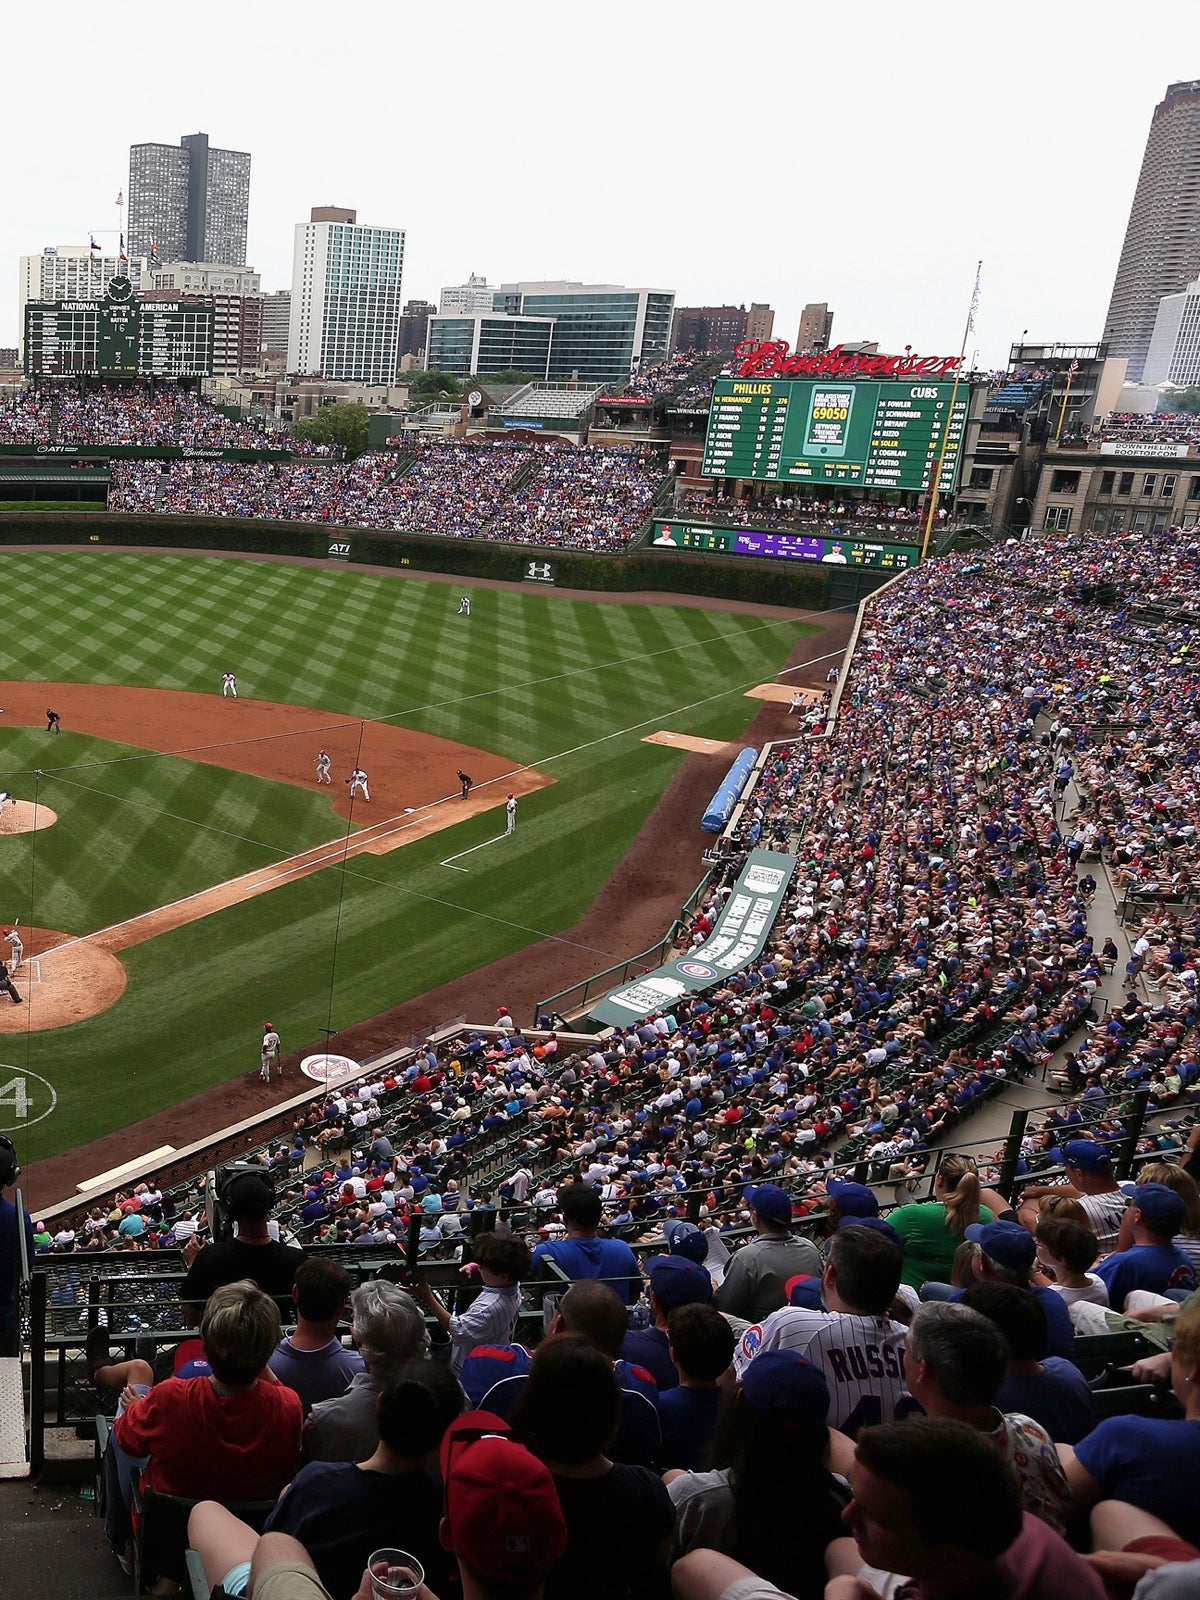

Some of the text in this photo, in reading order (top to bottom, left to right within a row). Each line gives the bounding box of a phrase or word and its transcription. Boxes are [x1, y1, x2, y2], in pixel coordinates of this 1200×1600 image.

[61, 302, 100, 311] NATIONAL
[140, 303, 179, 312] AMERICAN
[115, 324, 125, 332] 16
[734, 340, 966, 377] Budweiser
[732, 383, 772, 394] PHILLIES
[910, 387, 938, 398] CUBS
[812, 407, 848, 420] 69050
[885, 411, 922, 419] SCHWARBER
[181, 447, 224, 457] Budweiser
[927, 451, 934, 459] LF
[925, 461, 932, 469] SS
[788, 468, 812, 476] HAMMEL
[875, 469, 902, 477] HAMMEL
[873, 478, 897, 486] RUSSELL
[328, 543, 351, 553] ATI
